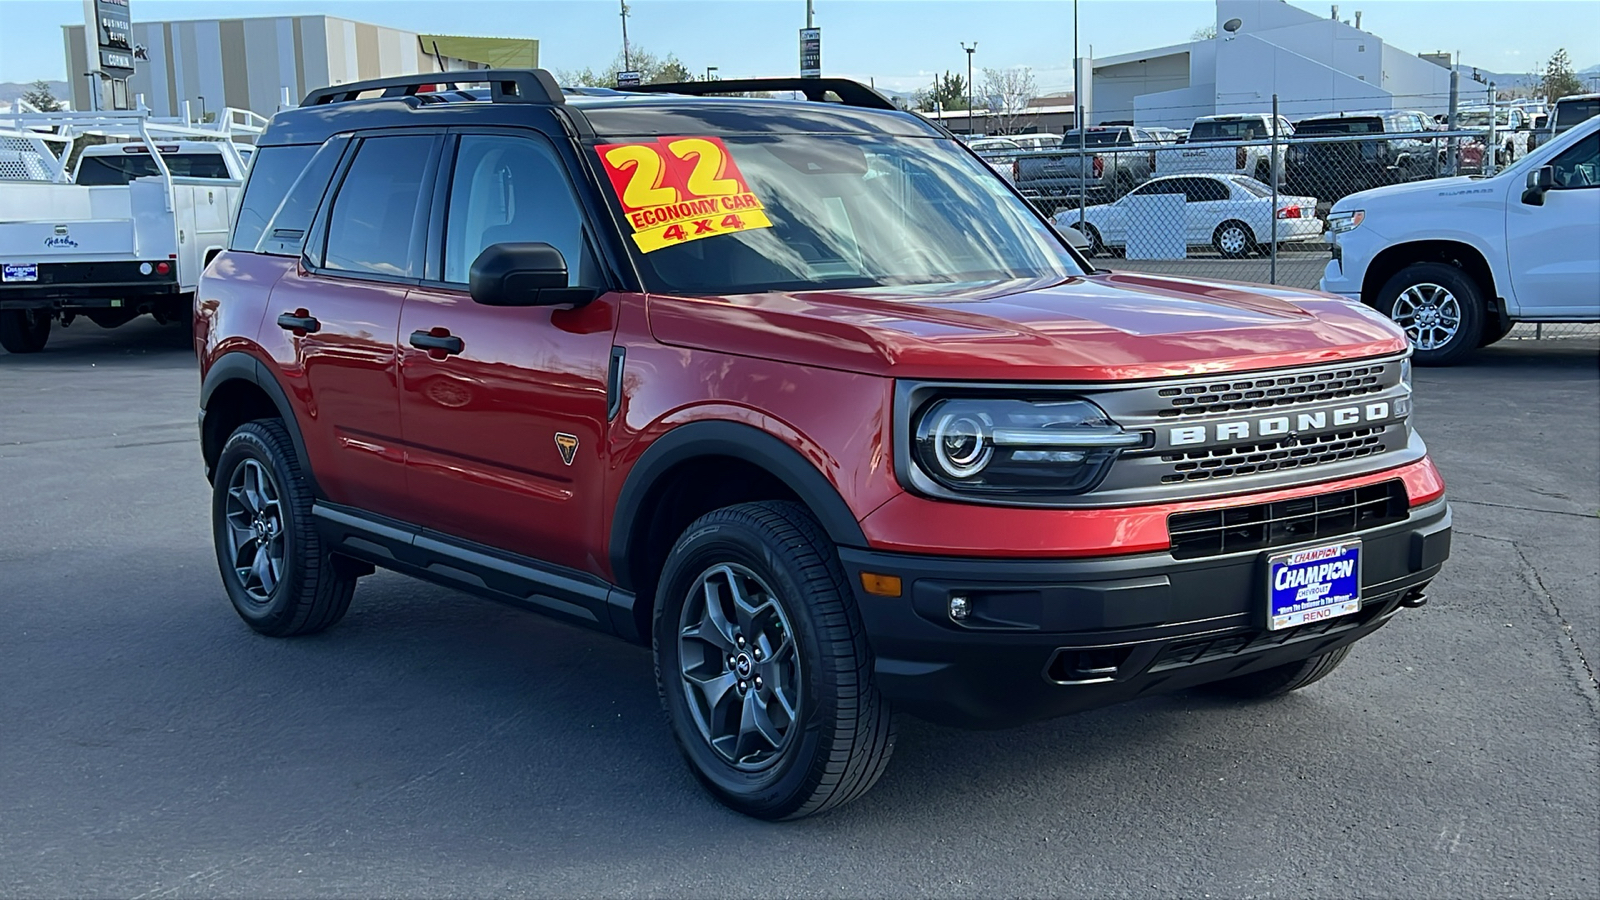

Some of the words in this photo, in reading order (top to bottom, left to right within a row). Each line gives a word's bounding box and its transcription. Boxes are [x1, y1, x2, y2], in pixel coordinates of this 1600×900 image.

[103, 18, 129, 30] BUSINESS
[110, 31, 126, 42] ELITE
[1438, 188, 1494, 197] SILVERADO
[631, 197, 718, 229] ECONOMY
[722, 194, 759, 210] CAR
[1169, 402, 1389, 446] BRONCO
[1294, 547, 1338, 563] CHAMPION
[1274, 559, 1354, 591] CHAMPION
[1298, 584, 1330, 598] CHEVROLET
[1303, 608, 1331, 622] RENO
